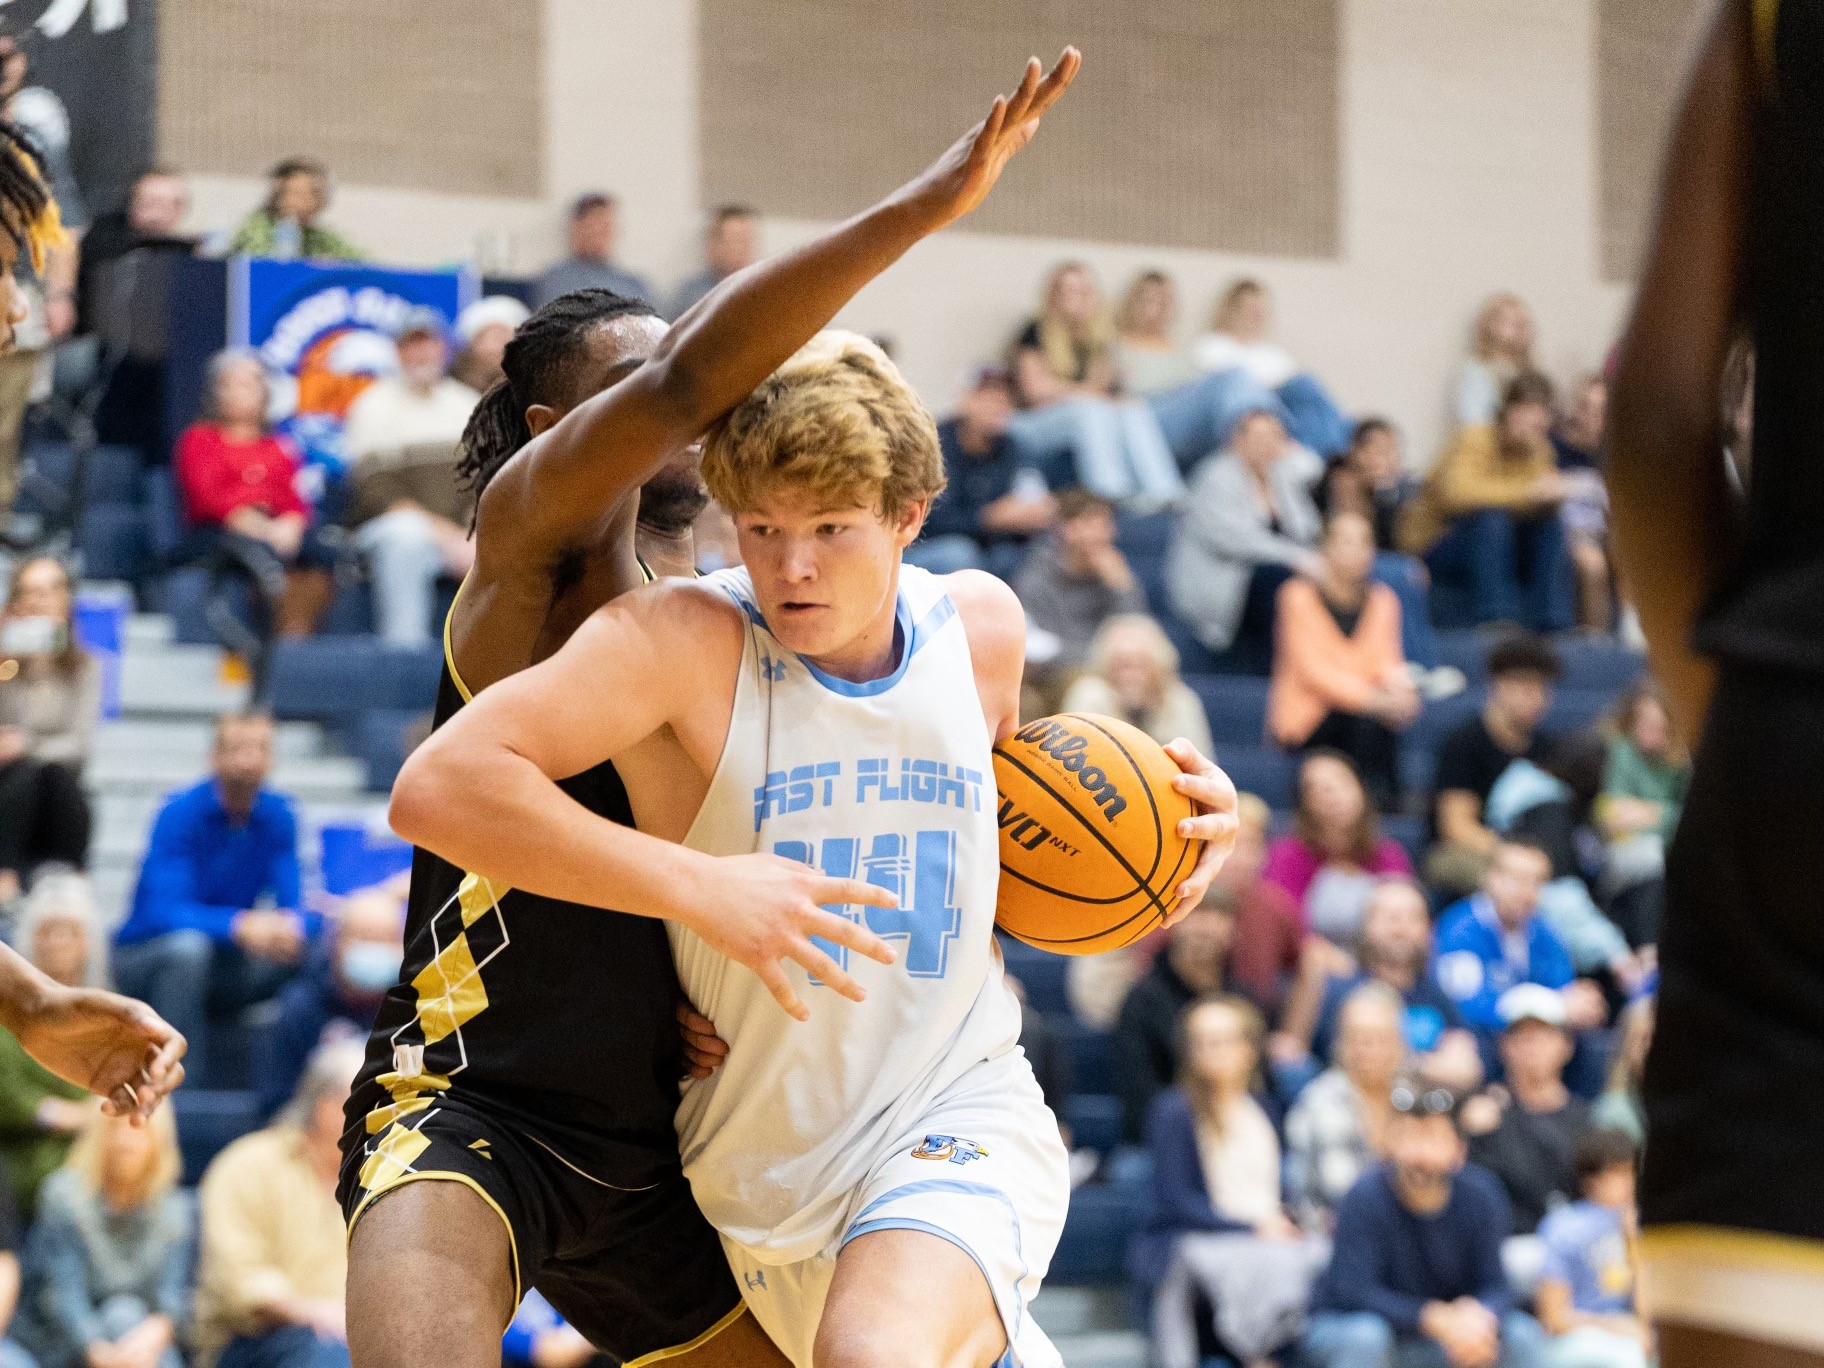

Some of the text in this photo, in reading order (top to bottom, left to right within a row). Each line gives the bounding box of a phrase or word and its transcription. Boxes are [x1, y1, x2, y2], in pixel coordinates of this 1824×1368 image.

[856, 757, 982, 812] FLIGHT
[1013, 720, 1128, 823] Wilson
[1063, 776, 1077, 791] BALL
[996, 789, 1081, 857] VO NXT
